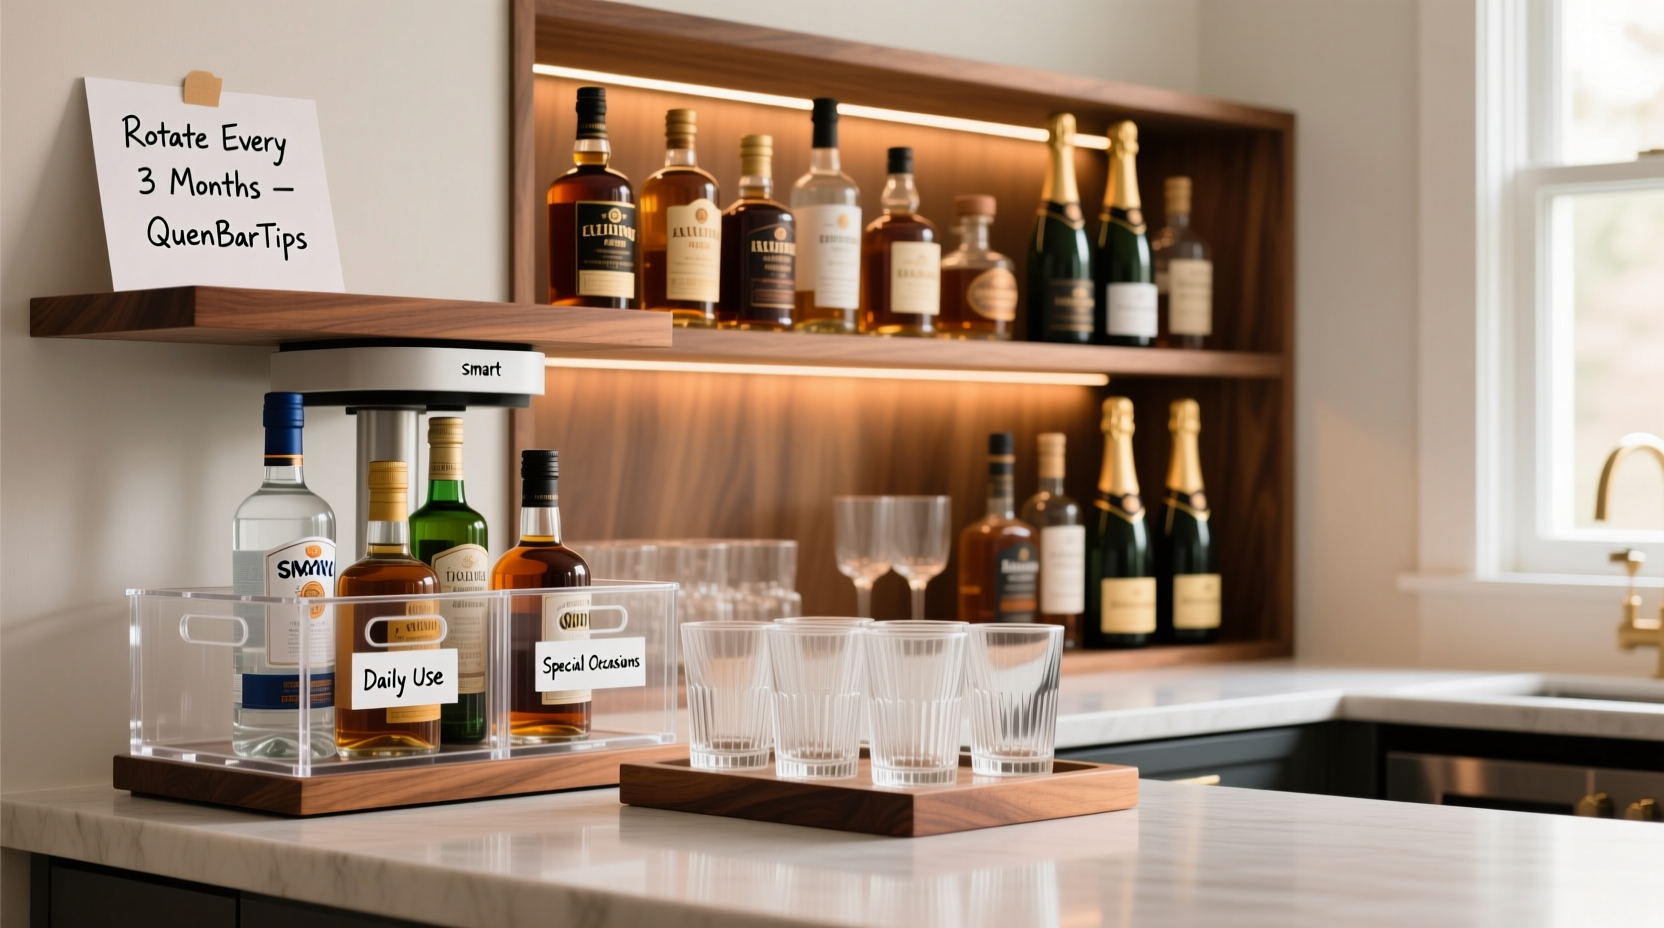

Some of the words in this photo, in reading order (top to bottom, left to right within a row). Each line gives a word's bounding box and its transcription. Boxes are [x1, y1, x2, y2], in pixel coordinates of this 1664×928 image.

[121, 114, 209, 149] Rotate
[221, 123, 287, 167] Every
[137, 167, 156, 195] 3
[170, 167, 261, 200] Months
[147, 215, 308, 262] QuenBarTips
[461, 361, 502, 377] smart
[363, 667, 407, 699] Daily
[413, 666, 445, 687] Use
[542, 654, 585, 681] Special
